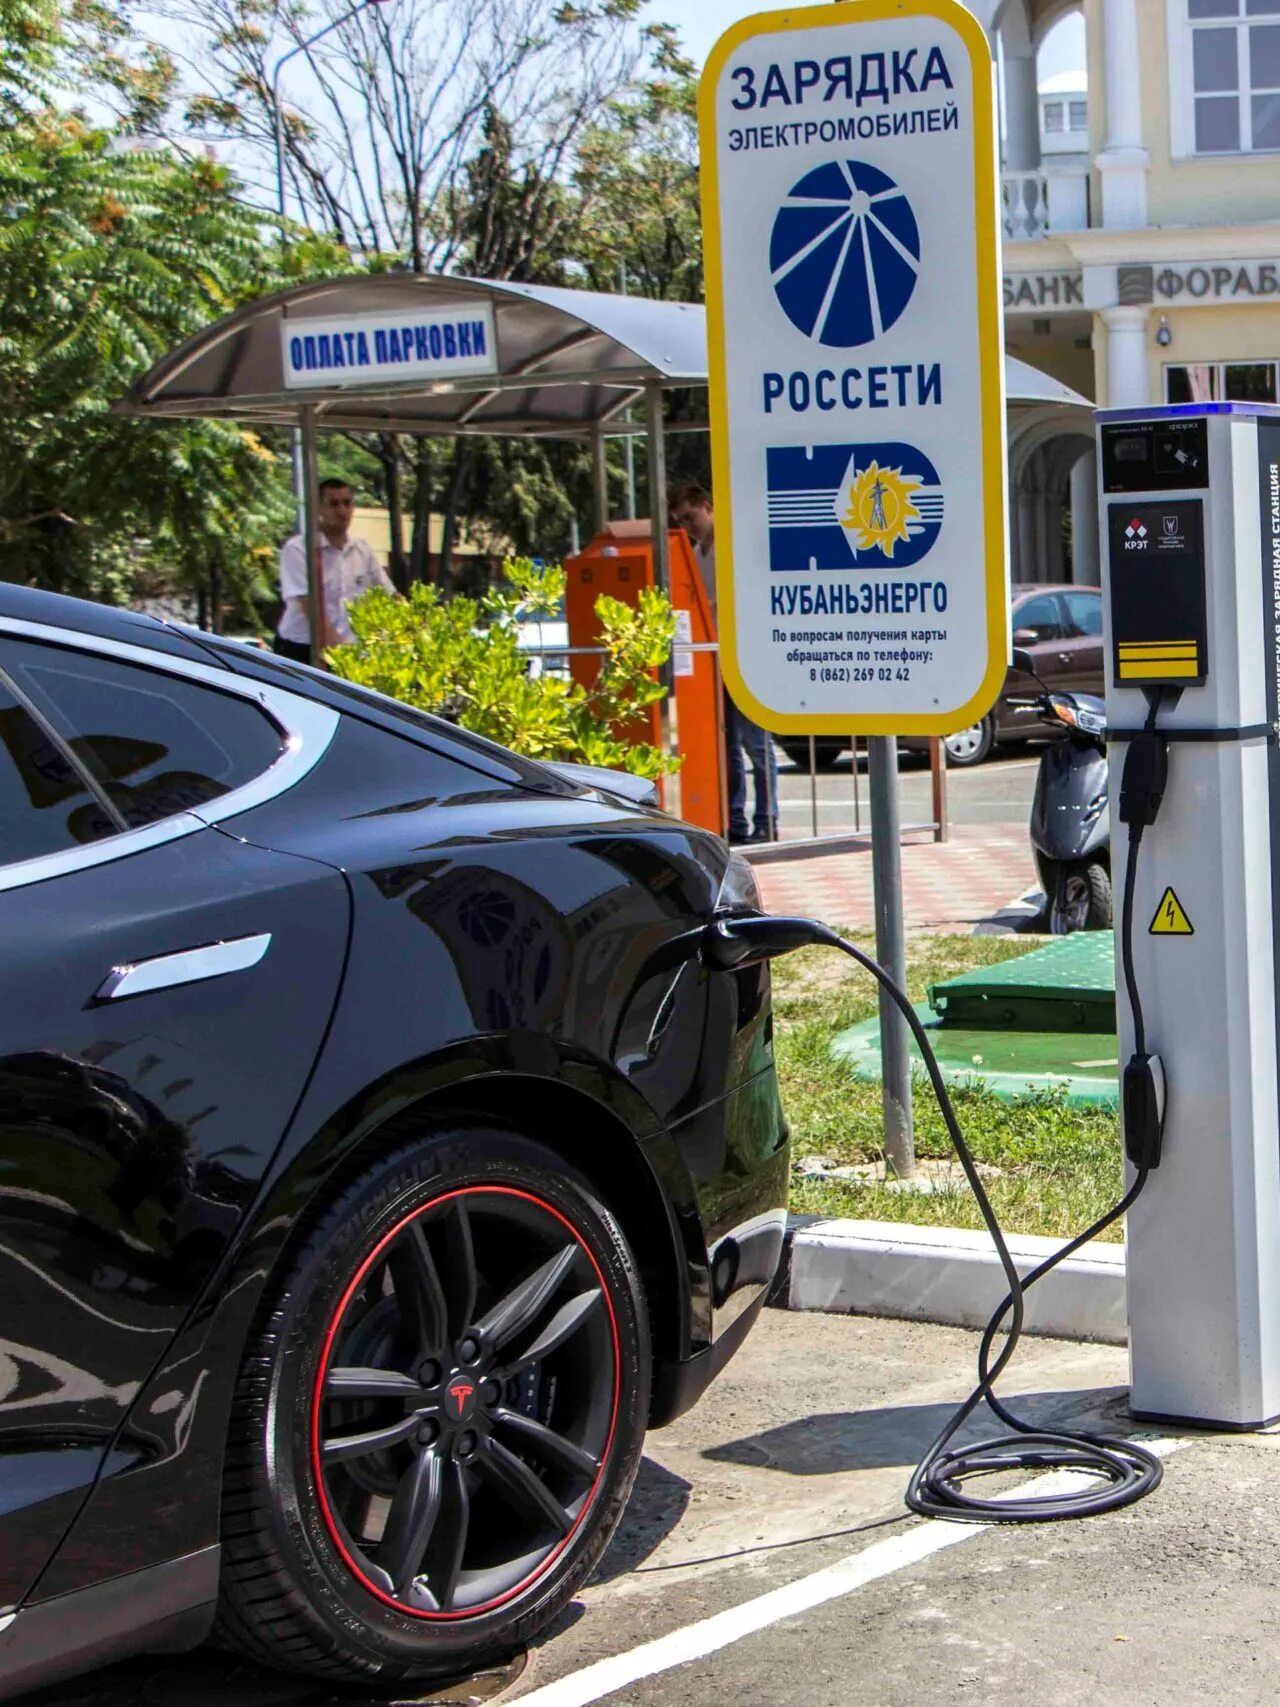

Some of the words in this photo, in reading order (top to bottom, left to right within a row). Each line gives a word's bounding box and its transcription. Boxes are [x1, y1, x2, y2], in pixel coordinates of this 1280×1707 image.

[730, 46, 954, 110] ЗАРЯДКА
[728, 101, 959, 151] ЭЛЕКТРОМОБИЛЕЙ
[290, 331, 370, 371] ОПЛАТА
[373, 321, 487, 365] ПАРКОВКИ
[763, 363, 942, 413] РОССЕТИ
[1269, 463, 1280, 533] СТАНЦИЯ
[1124, 540, 1149, 550] КРЭТ
[770, 582, 948, 616] КУБАНЬЭНЕРГО
[772, 629, 787, 642] По
[790, 630, 843, 645] вопросам
[847, 629, 908, 644] получения
[911, 629, 947, 643] карты
[786, 649, 853, 664] обращаться
[857, 651, 870, 661] по
[874, 648, 933, 664] телефону:
[809, 668, 817, 681] 8
[820, 668, 850, 683] (862)
[854, 668, 874, 681] 269
[878, 668, 892, 681] 02
[896, 668, 910, 681] 42
